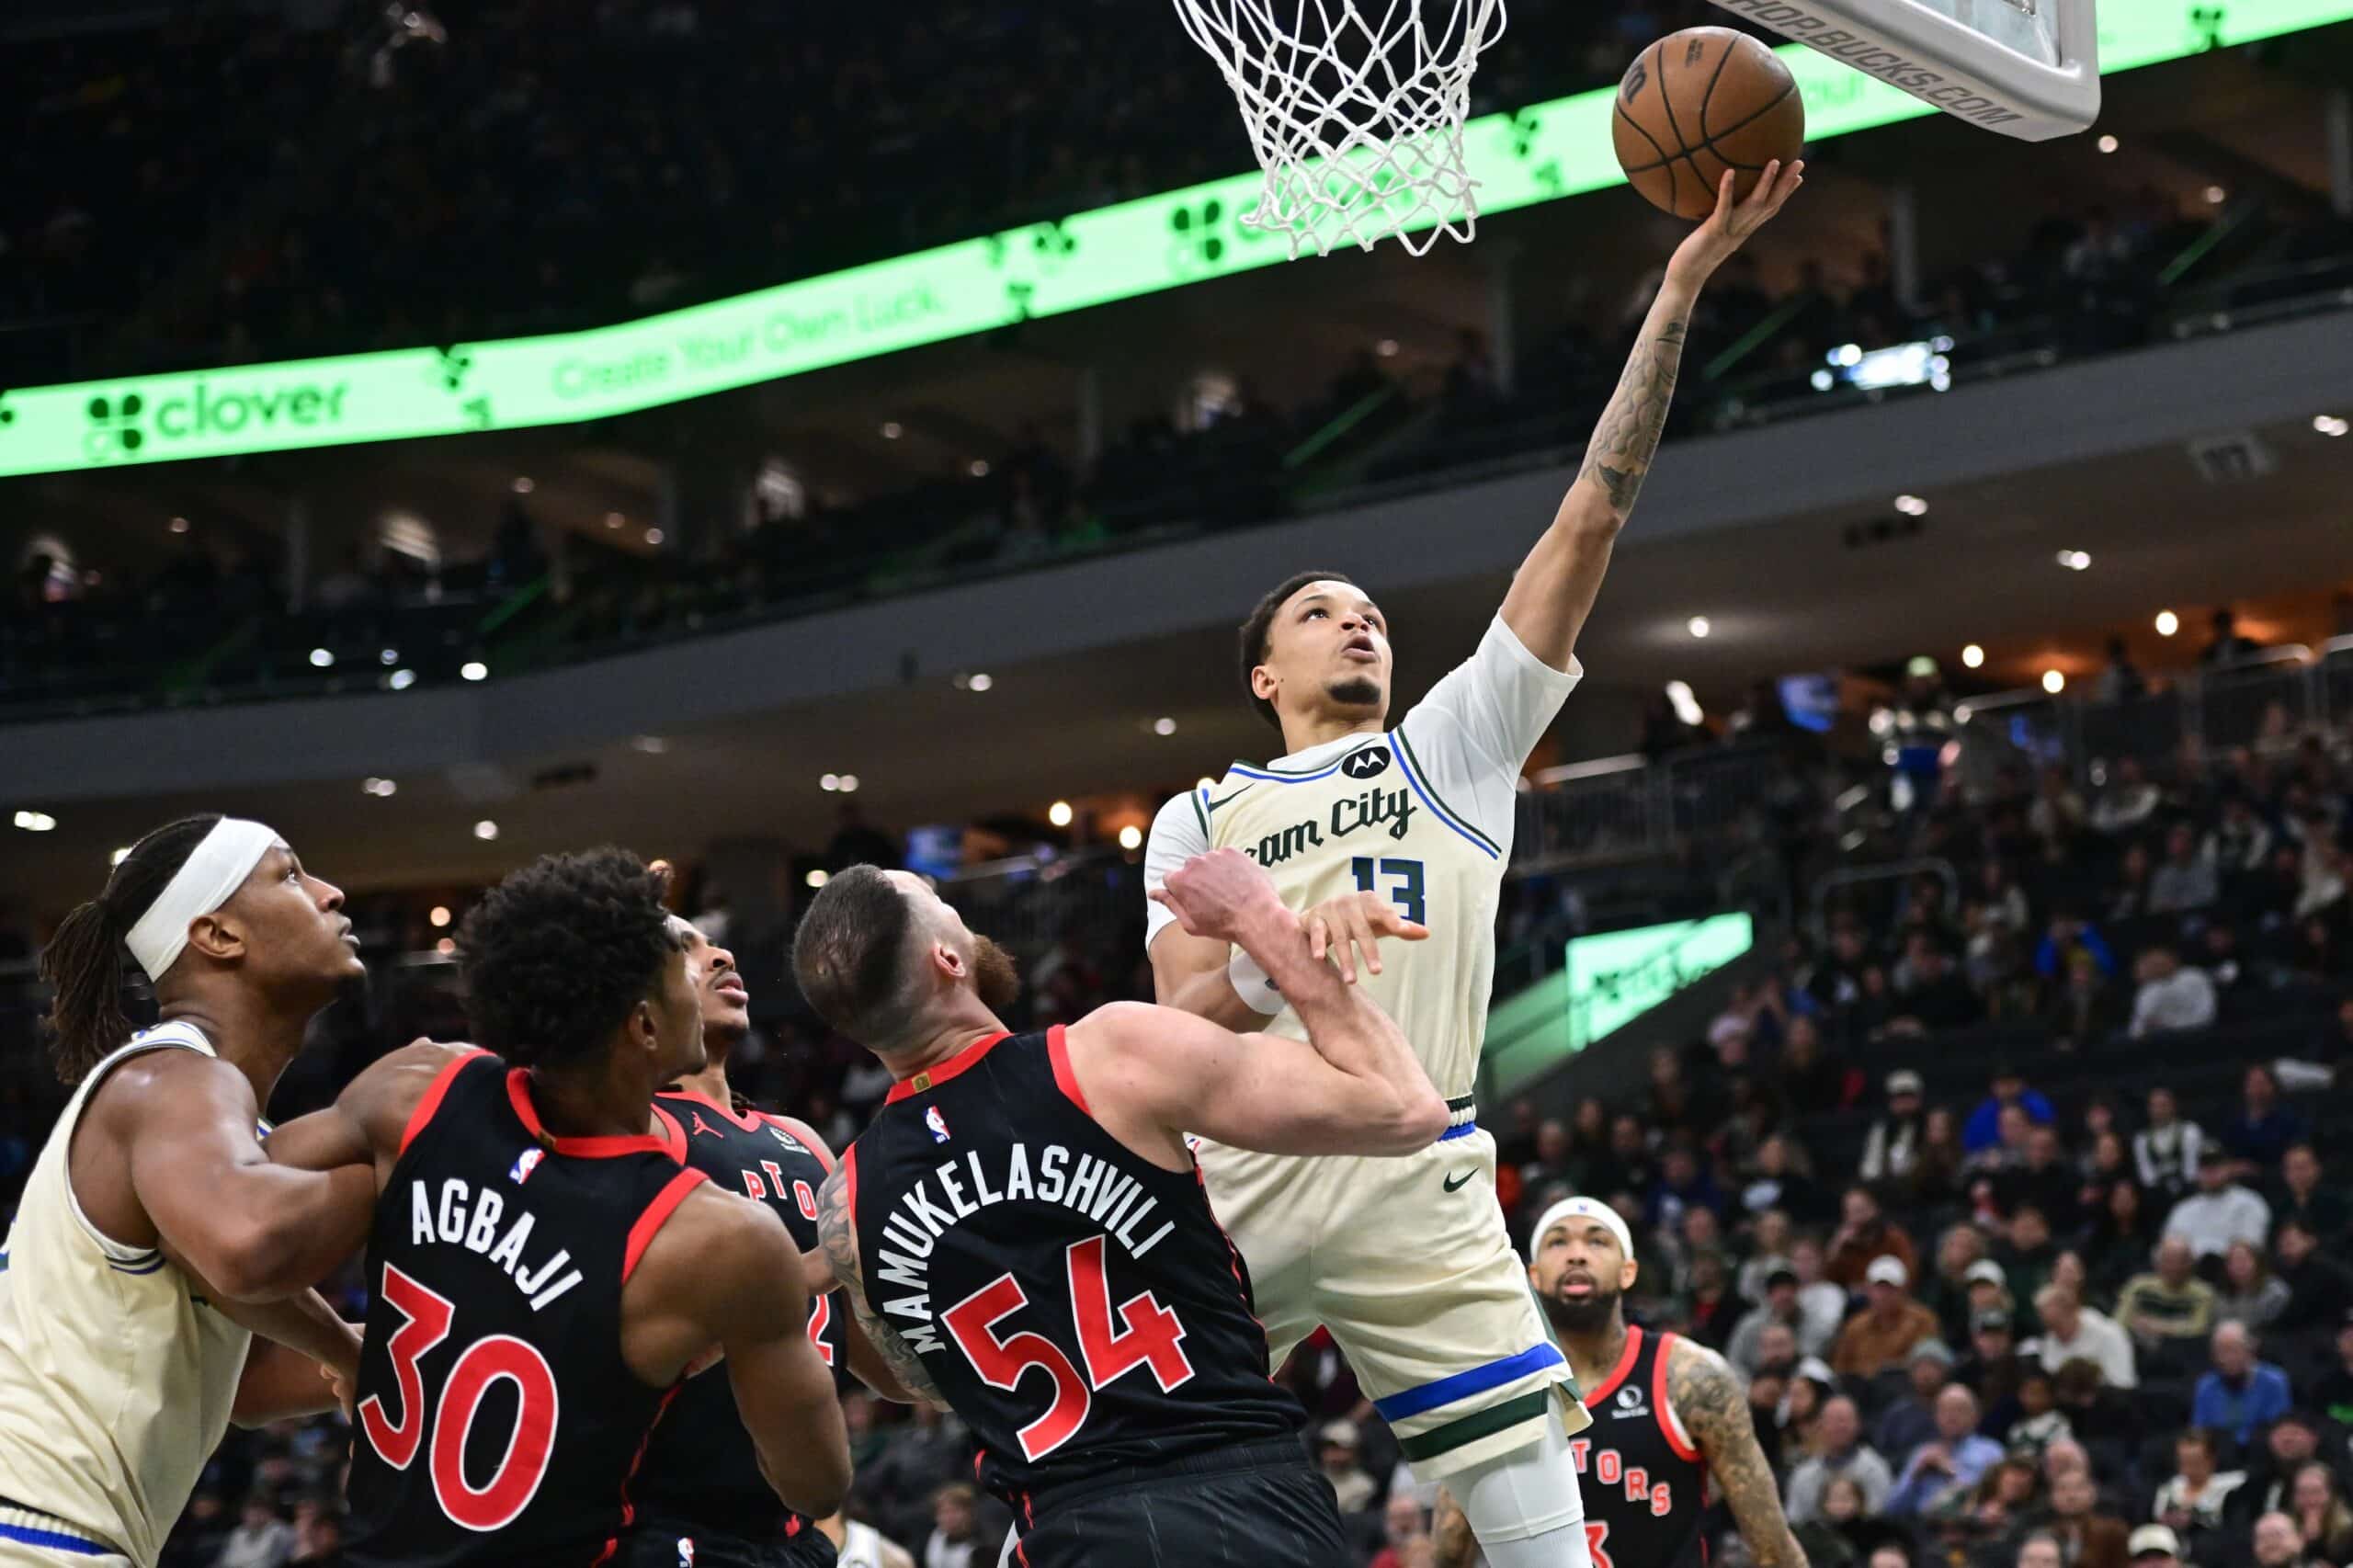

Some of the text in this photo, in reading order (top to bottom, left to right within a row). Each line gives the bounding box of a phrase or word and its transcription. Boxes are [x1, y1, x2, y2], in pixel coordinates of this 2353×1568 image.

[156, 381, 348, 437] clover
[551, 347, 673, 399] Create
[676, 327, 756, 367] Your
[764, 310, 848, 354] Own
[1245, 787, 1417, 867] am City
[1352, 857, 1425, 926] 13
[413, 1178, 584, 1312] AGBAJI
[878, 1142, 1176, 1355] MAMUKELASHVILI
[357, 1260, 560, 1532] 30
[939, 1233, 1196, 1464] 54
